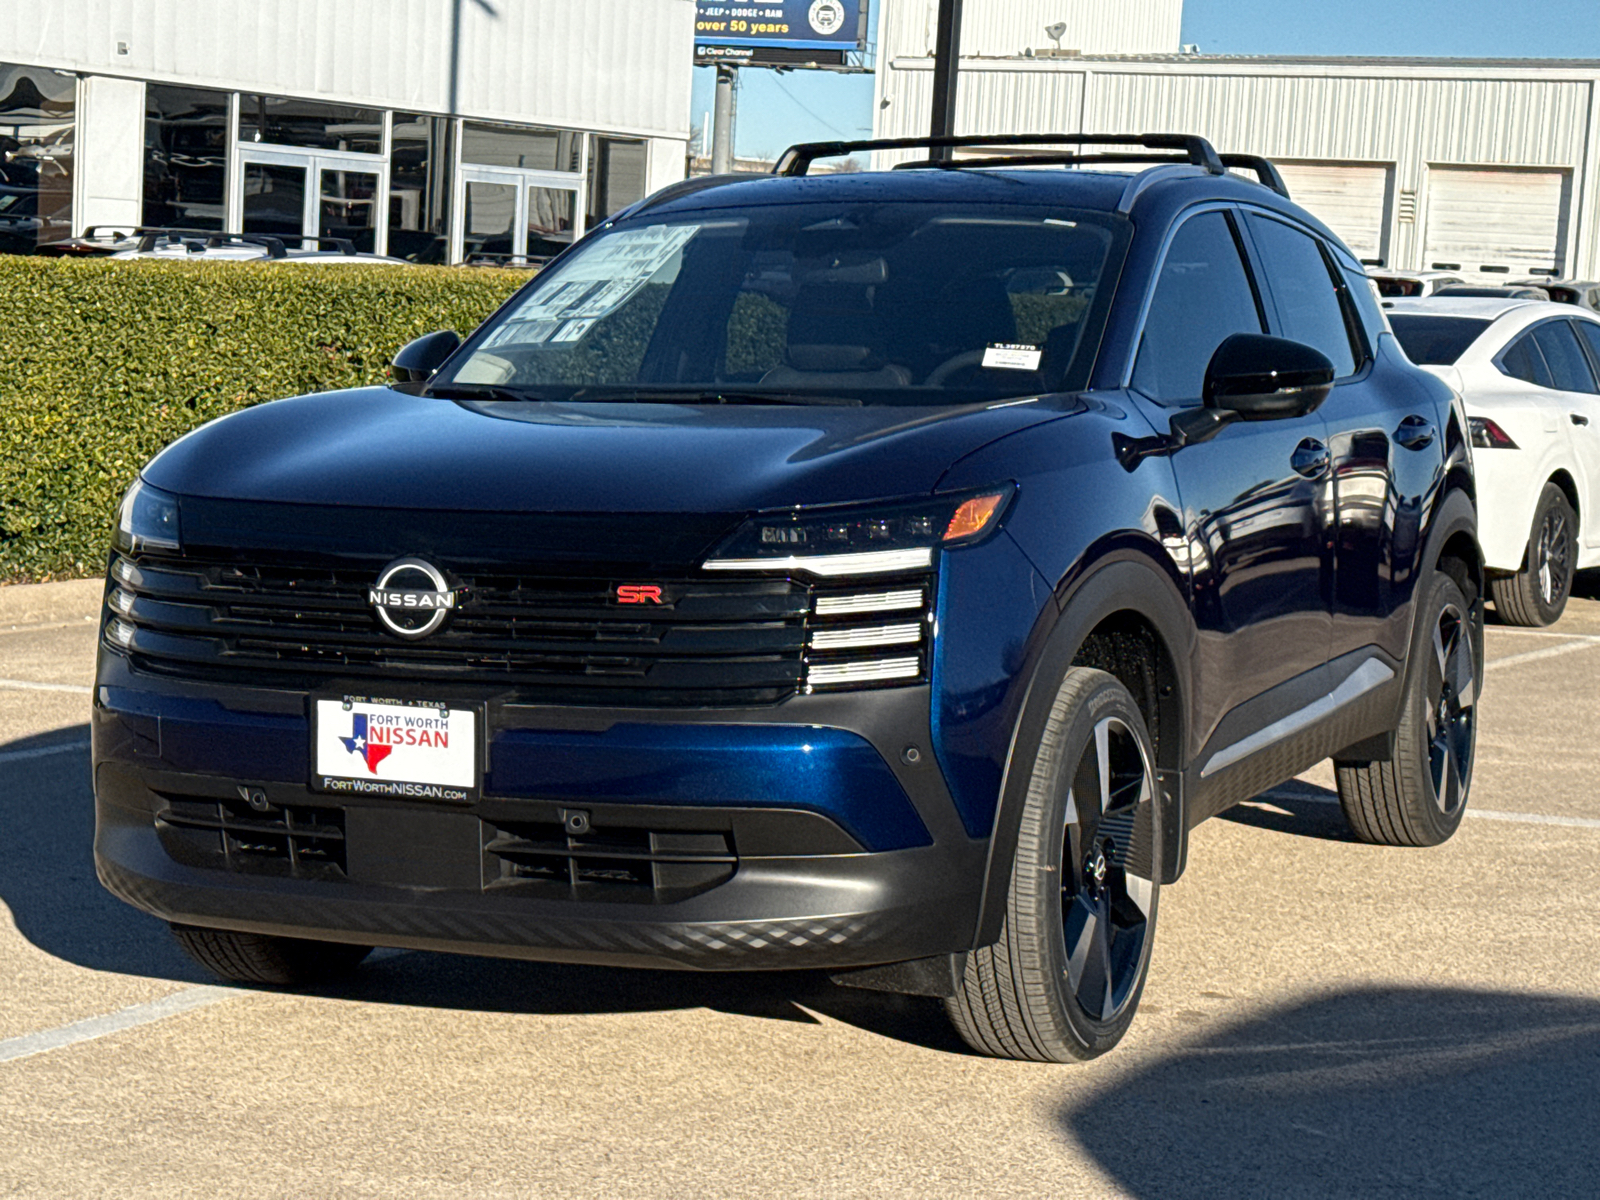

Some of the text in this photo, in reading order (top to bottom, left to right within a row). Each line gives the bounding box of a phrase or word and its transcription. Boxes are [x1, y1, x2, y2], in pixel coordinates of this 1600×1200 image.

[696, 20, 789, 35] over 50 years
[370, 590, 453, 608] NISSAN
[616, 585, 662, 604] SR
[343, 695, 446, 709] FORT WORTH TEXAS
[369, 714, 449, 730] FORT WORTH
[370, 726, 448, 748] NISSAN
